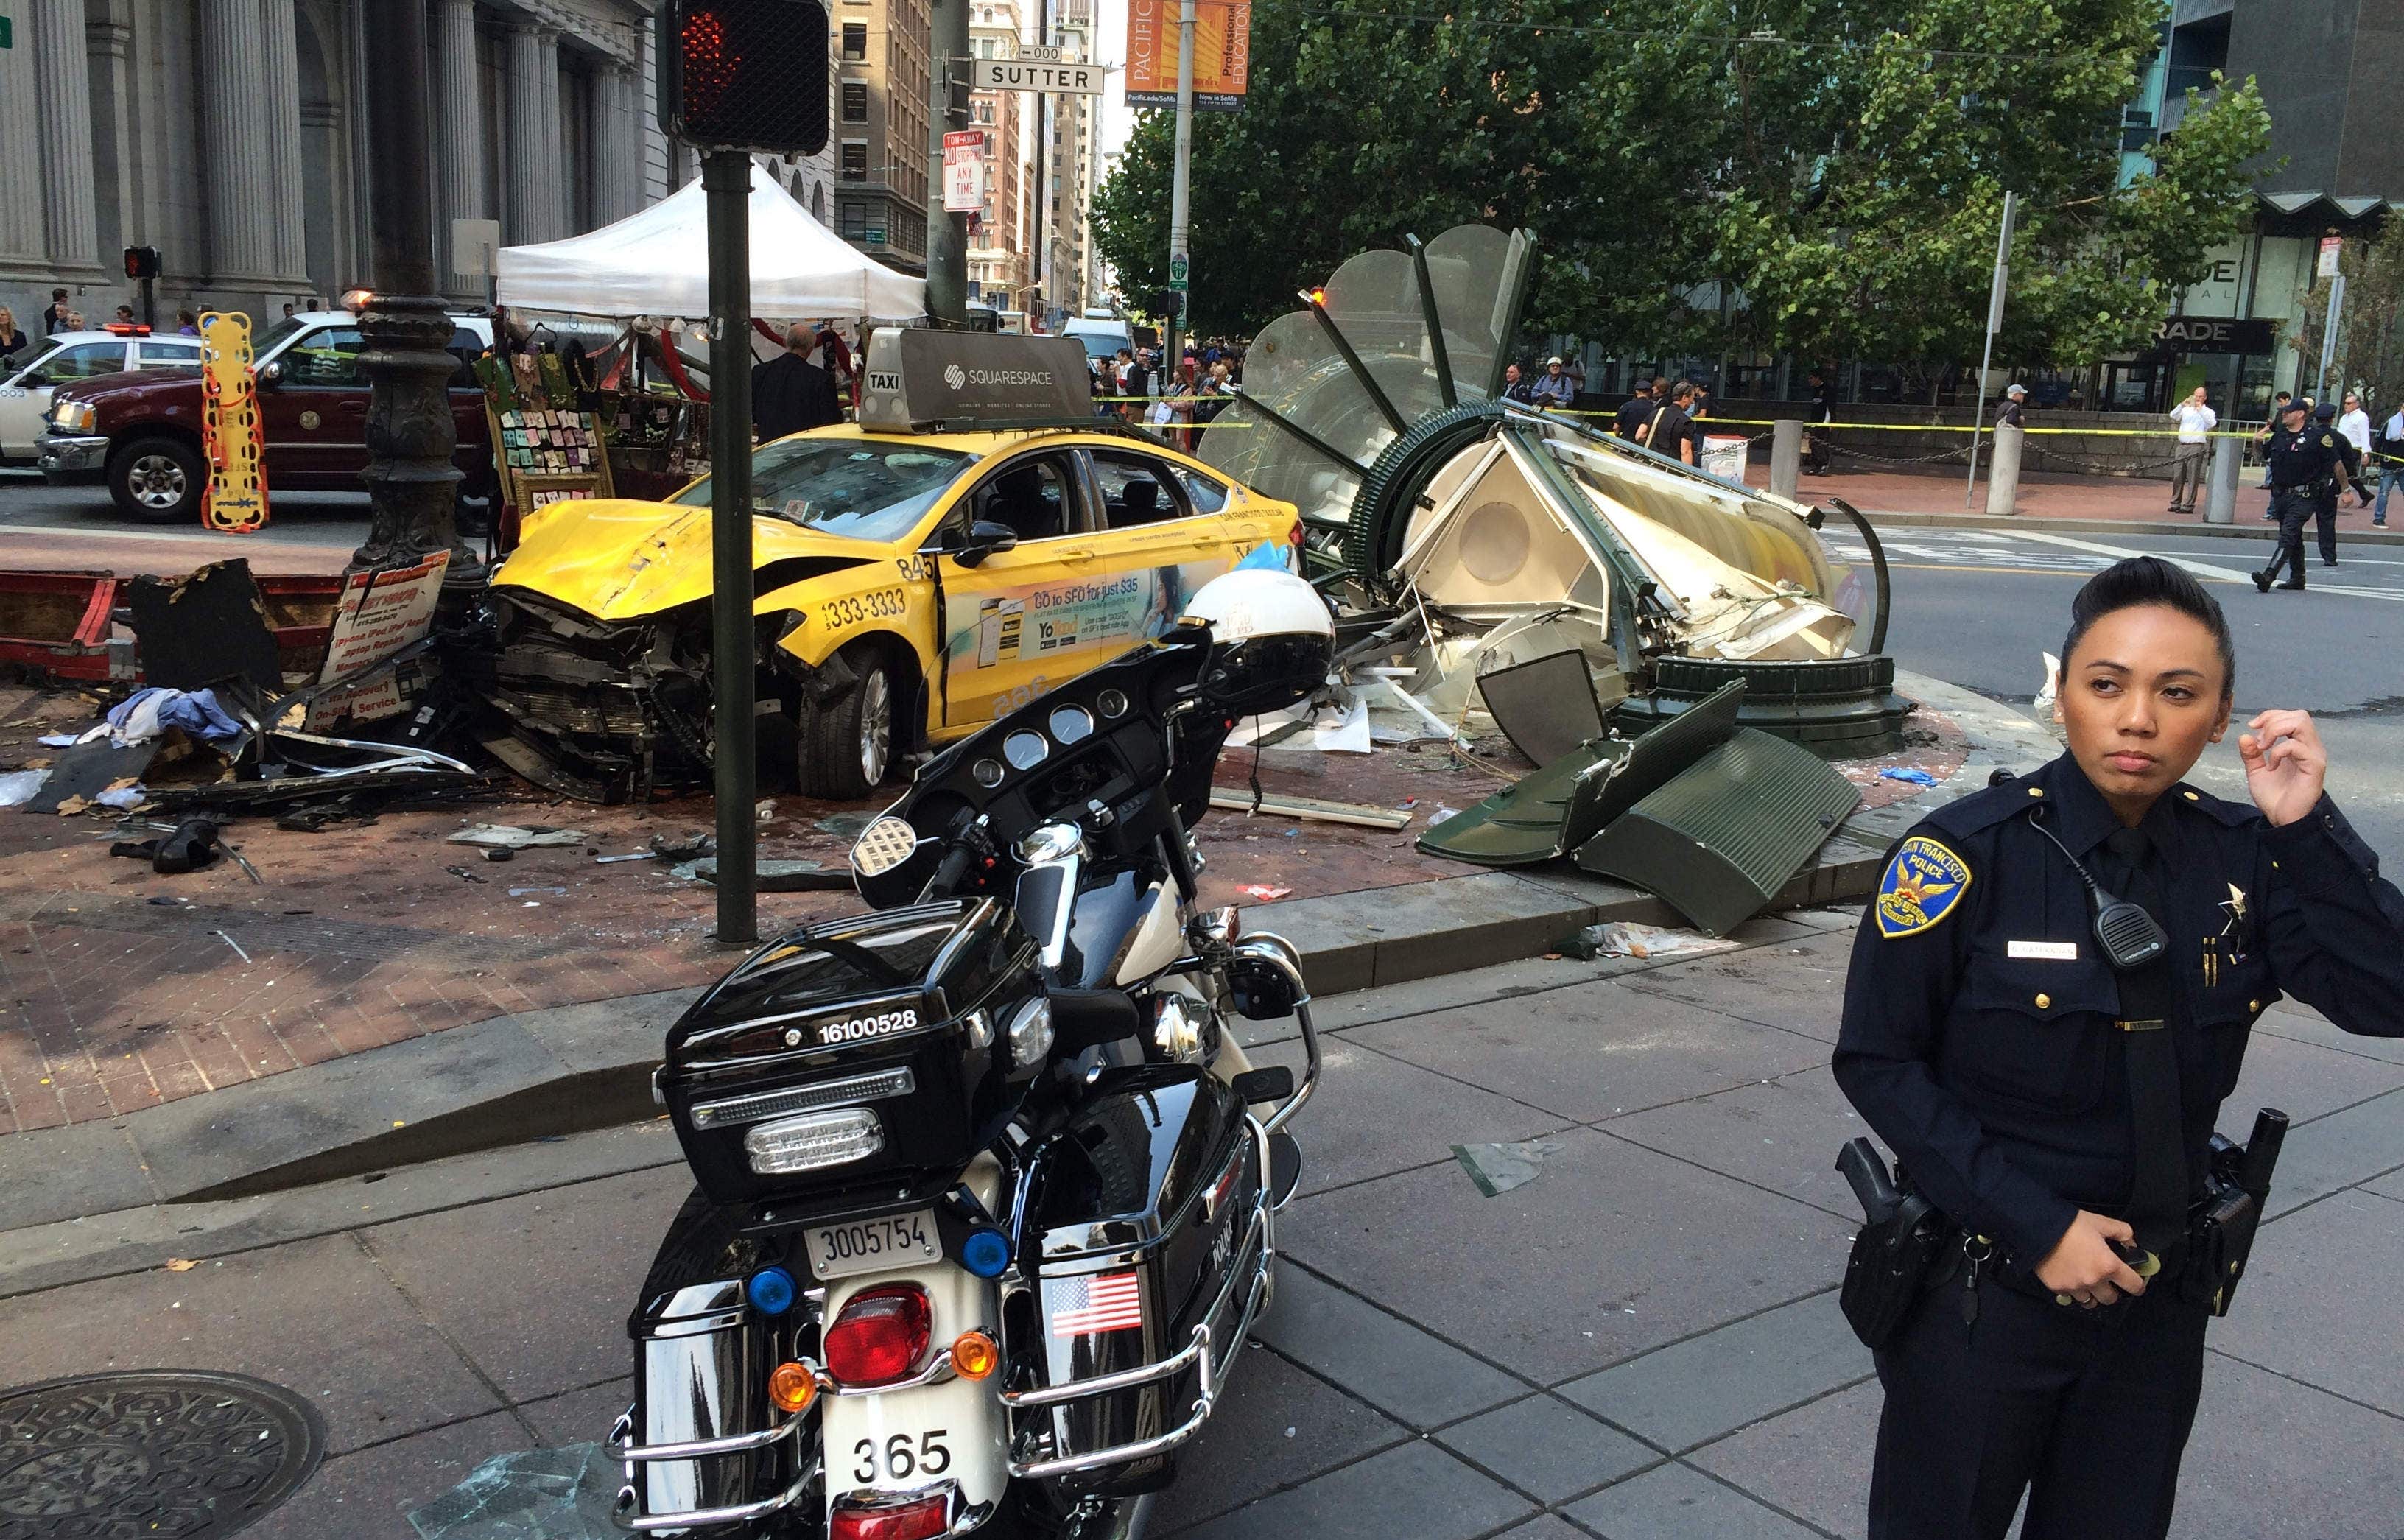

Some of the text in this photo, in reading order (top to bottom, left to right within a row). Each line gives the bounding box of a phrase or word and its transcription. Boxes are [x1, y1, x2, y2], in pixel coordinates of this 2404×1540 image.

[1134, 1, 1153, 80] PACIFIC
[1223, 5, 1235, 77] Professional
[1232, 4, 1248, 85] EDUCATION
[1034, 48, 1058, 59] 000
[991, 66, 1089, 88] SUTTER
[947, 134, 980, 145] TOW-AWAY
[945, 147, 982, 164] NO STOPPING
[957, 166, 972, 179] ANY
[957, 182, 974, 195] TIME
[870, 373, 899, 390] TAXI
[969, 370, 1052, 385] SQUARESPACE
[896, 553, 934, 581] 845
[1034, 577, 1138, 609] GO to SFO for just $35
[828, 588, 906, 627] 333-3333
[368, 627, 387, 639] iPod
[373, 635, 404, 650] Repairs
[345, 680, 389, 700] Recovery
[359, 697, 397, 714] Service
[1904, 841, 1967, 882] SAN FRANCISCO
[1908, 854, 1945, 879] POLICE
[819, 1009, 917, 1044] 16100528
[820, 1216, 926, 1261] 3005754
[1212, 1214, 1233, 1271] POLICE
[853, 1429, 951, 1483] 365
